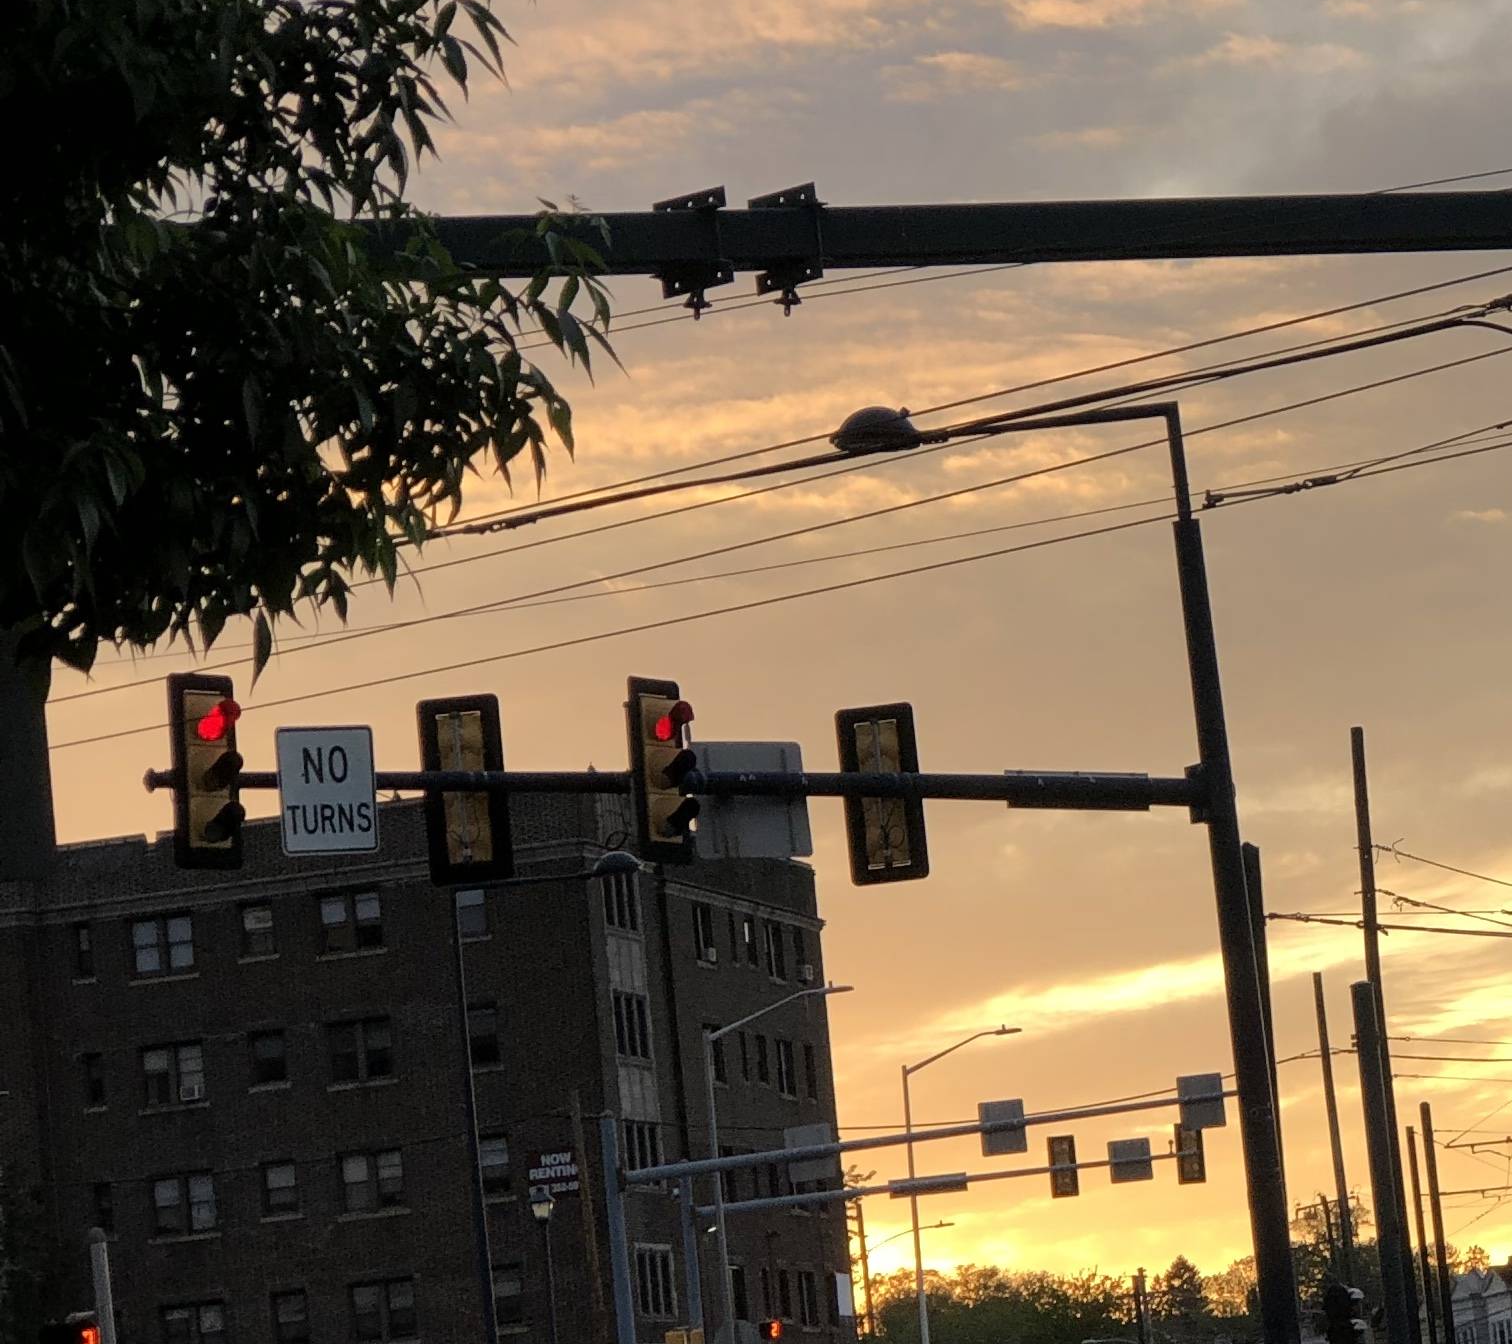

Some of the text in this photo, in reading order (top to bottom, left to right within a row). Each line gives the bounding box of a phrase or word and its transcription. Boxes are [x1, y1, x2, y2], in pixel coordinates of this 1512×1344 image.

[302, 745, 348, 784] NO
[286, 802, 372, 835] TURNS
[529, 1163, 578, 1180] RENTIN
[540, 1152, 571, 1166] NOW
